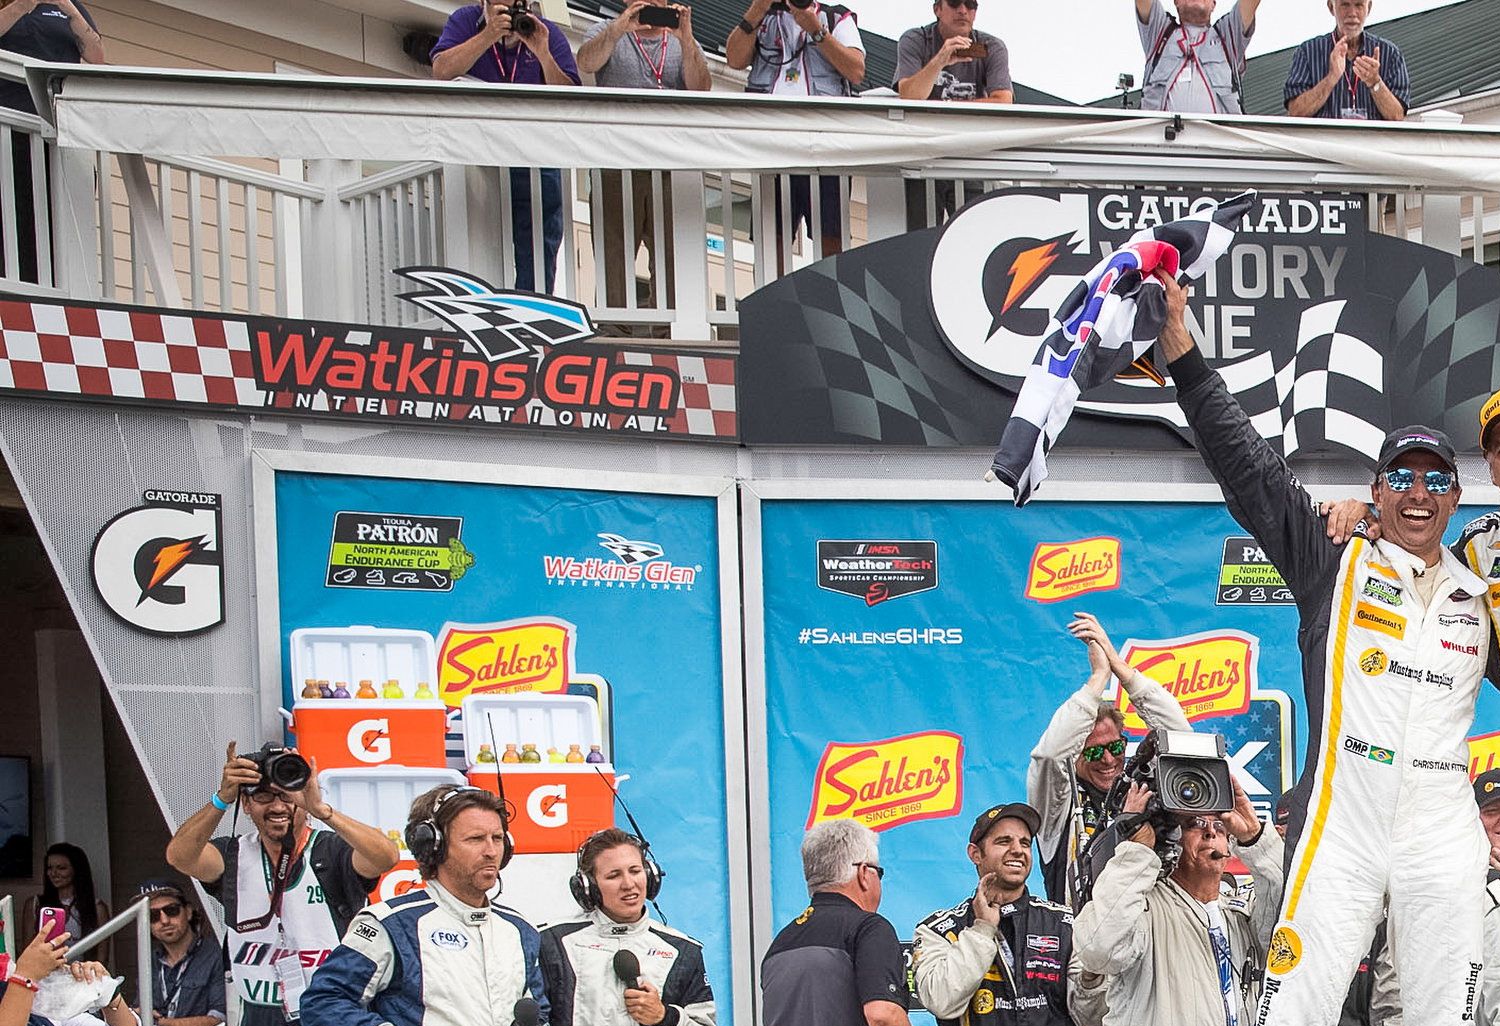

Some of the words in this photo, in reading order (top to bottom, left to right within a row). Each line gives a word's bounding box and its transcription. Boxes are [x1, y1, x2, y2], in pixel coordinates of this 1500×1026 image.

[256, 331, 530, 399] Watkins
[543, 354, 674, 410] Glen
[263, 390, 670, 432] INTERNATIONAL
[145, 490, 216, 505] GATORADE
[382, 517, 412, 527] TEQUILA
[357, 523, 439, 545] PATRÓN
[94, 508, 221, 633] G
[543, 555, 643, 582] Watkins
[644, 561, 697, 585] Glen
[822, 558, 934, 571] WeatherTech
[1035, 546, 1114, 589] Sahlen's
[547, 580, 694, 591] INTERNATIONAL
[1357, 609, 1397, 629] Continental
[443, 636, 559, 693] Sahlen's
[1195, 701, 1215, 713] 1869
[347, 718, 393, 764] G
[1343, 737, 1370, 755] OMP
[1412, 759, 1450, 772] CHRISTIAN
[823, 748, 950, 818] Sahlen's
[526, 784, 569, 828] G
[865, 809, 897, 823] SINCE
[899, 802, 922, 815] 1869
[277, 853, 290, 880] Canon
[355, 924, 378, 939] OMP
[438, 931, 460, 943] FOX
[1461, 961, 1483, 1022] Sampling
